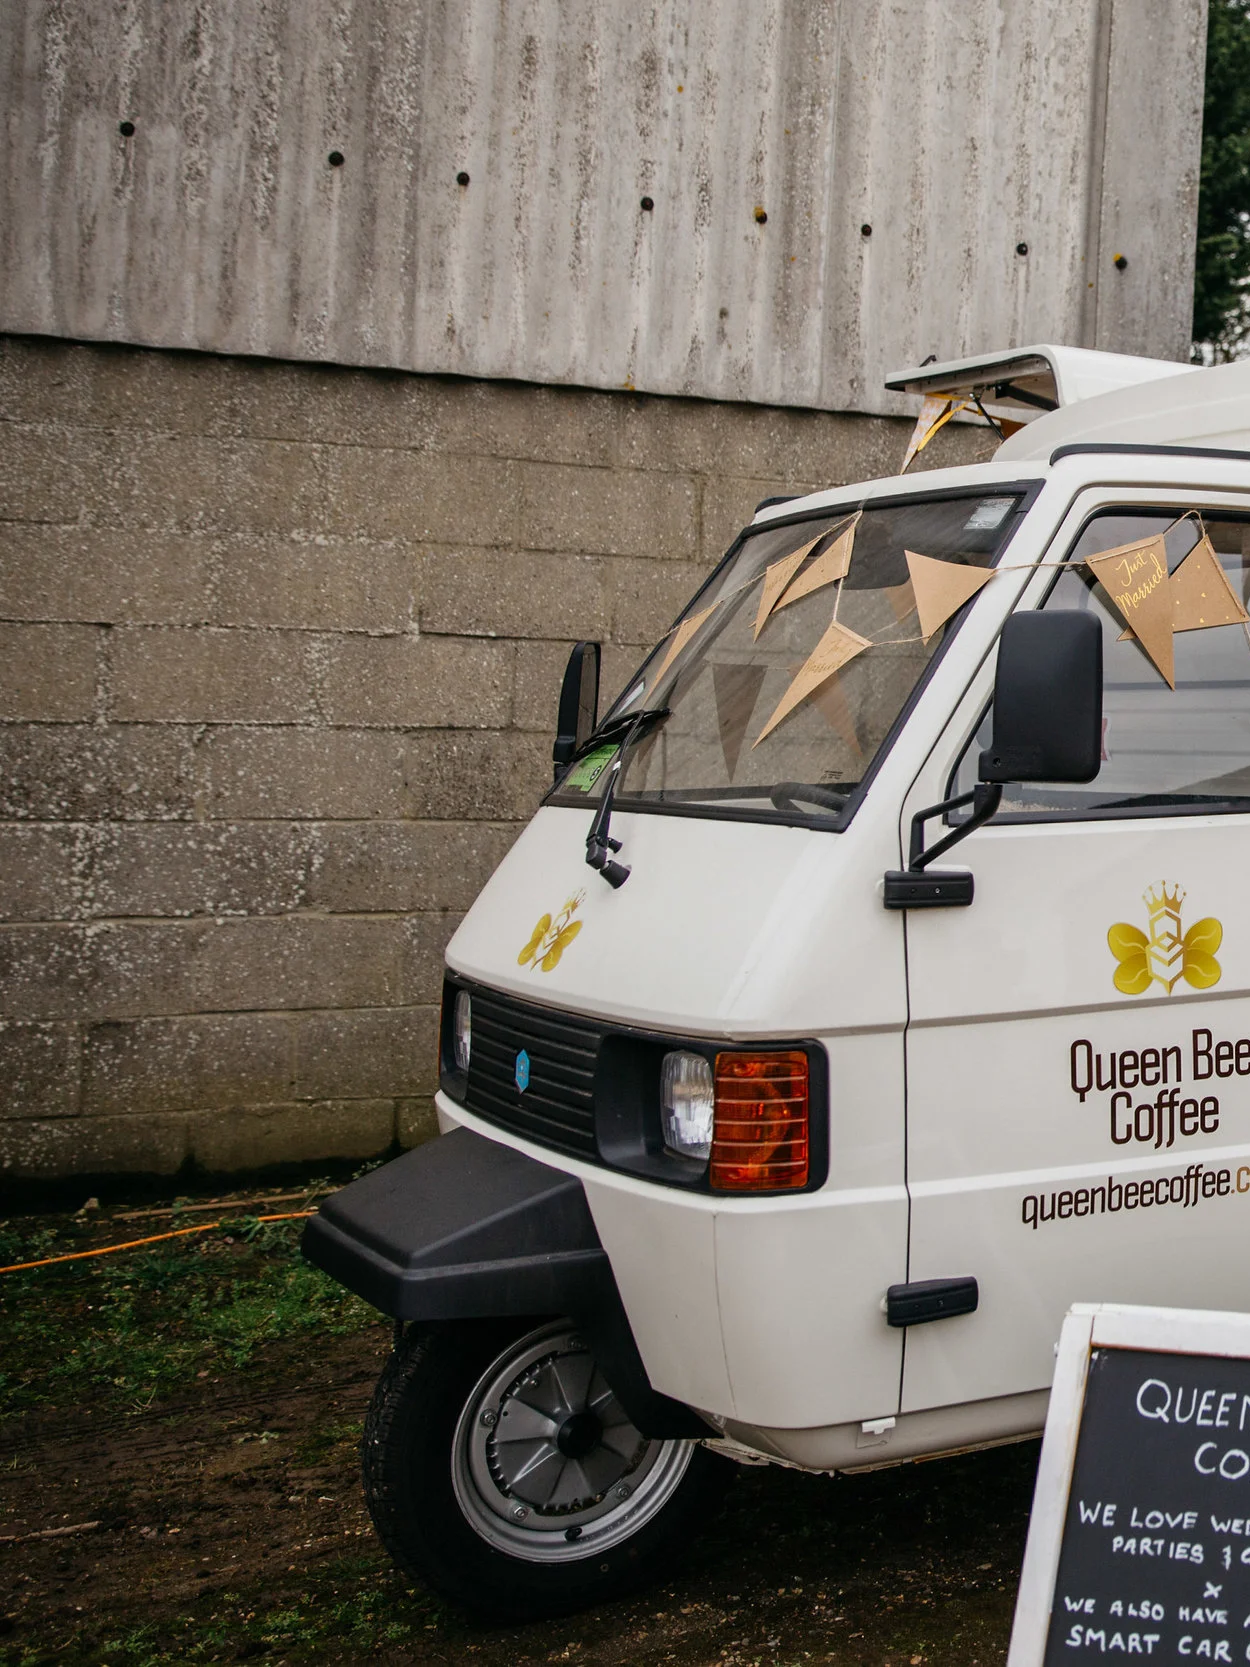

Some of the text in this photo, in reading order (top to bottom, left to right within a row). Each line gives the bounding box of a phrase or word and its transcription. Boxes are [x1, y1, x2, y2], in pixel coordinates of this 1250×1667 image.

[1114, 549, 1149, 587] Just
[1115, 552, 1168, 617] Married
[1070, 1039, 1182, 1102] Queen
[1110, 1088, 1219, 1149] Coffee
[1079, 1500, 1117, 1527] WE
[1130, 1506, 1198, 1529] LOVE
[1112, 1535, 1205, 1564] PARTIES
[1064, 1595, 1096, 1614] WE
[1110, 1600, 1165, 1621] ALSO
[1178, 1606, 1228, 1625] HAVE
[1065, 1624, 1160, 1655] SMART
[1178, 1635, 1232, 1663] CAR
